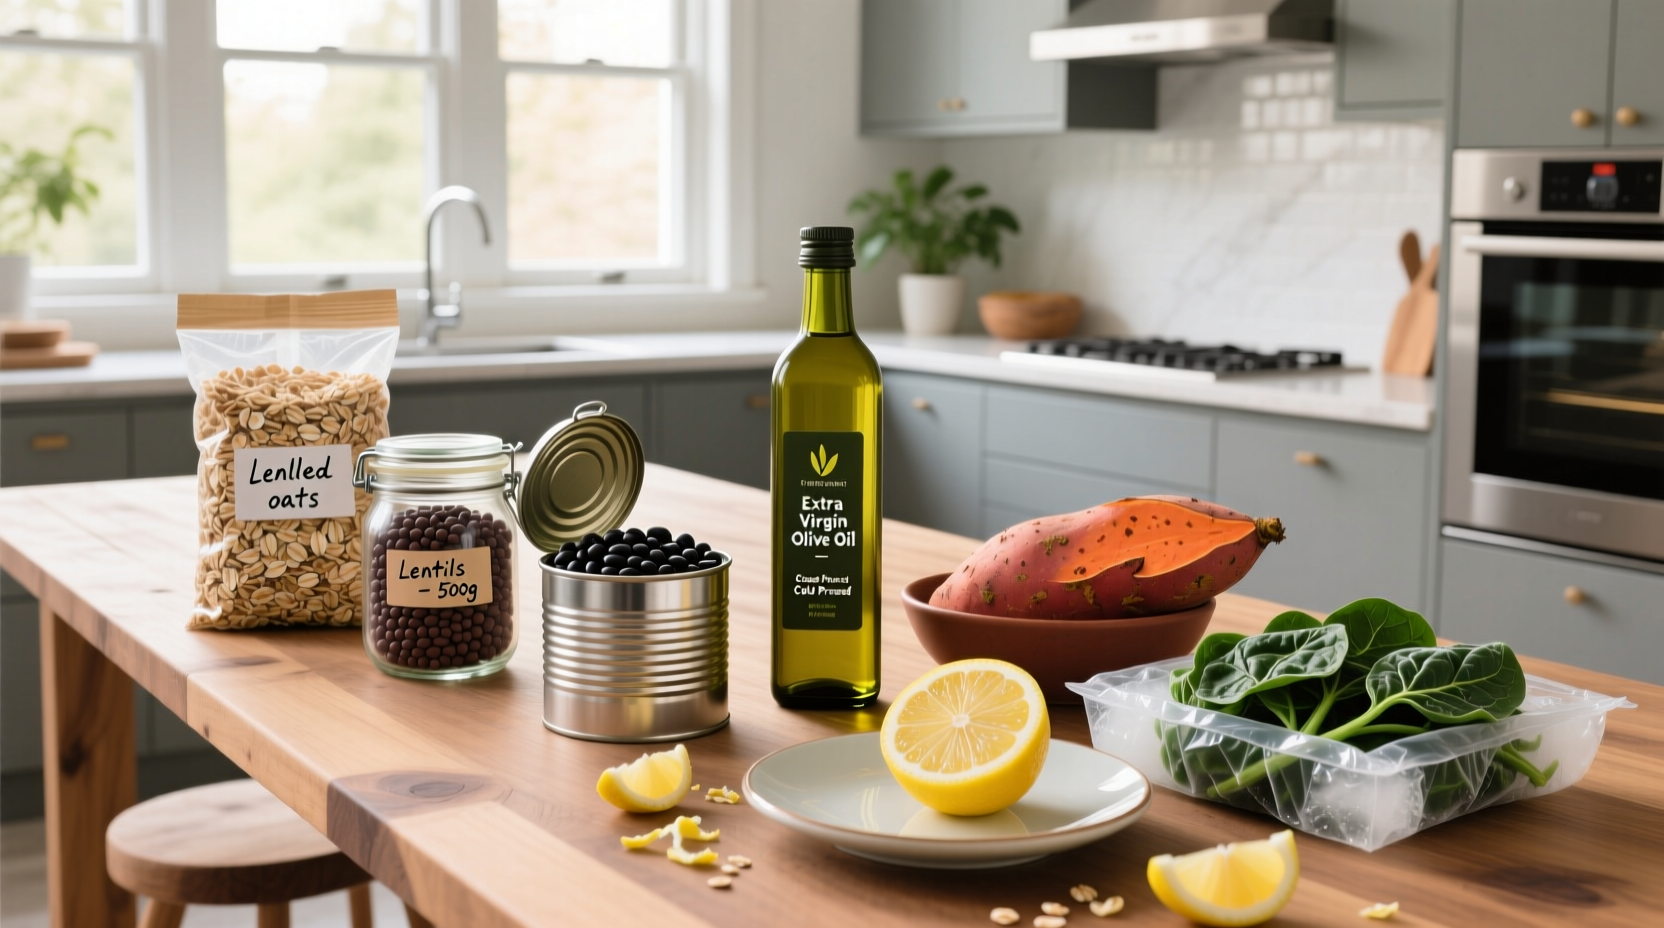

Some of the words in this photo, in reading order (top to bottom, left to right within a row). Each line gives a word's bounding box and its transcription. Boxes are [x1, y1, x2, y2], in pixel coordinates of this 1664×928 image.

[249, 455, 333, 485] Lenlled
[268, 487, 319, 509] oats
[801, 496, 843, 511] Extra
[799, 513, 848, 532] Virgin
[791, 531, 830, 547] Olive
[834, 531, 856, 547] Oil
[398, 558, 465, 580] Lentils
[437, 581, 478, 603] 500g
